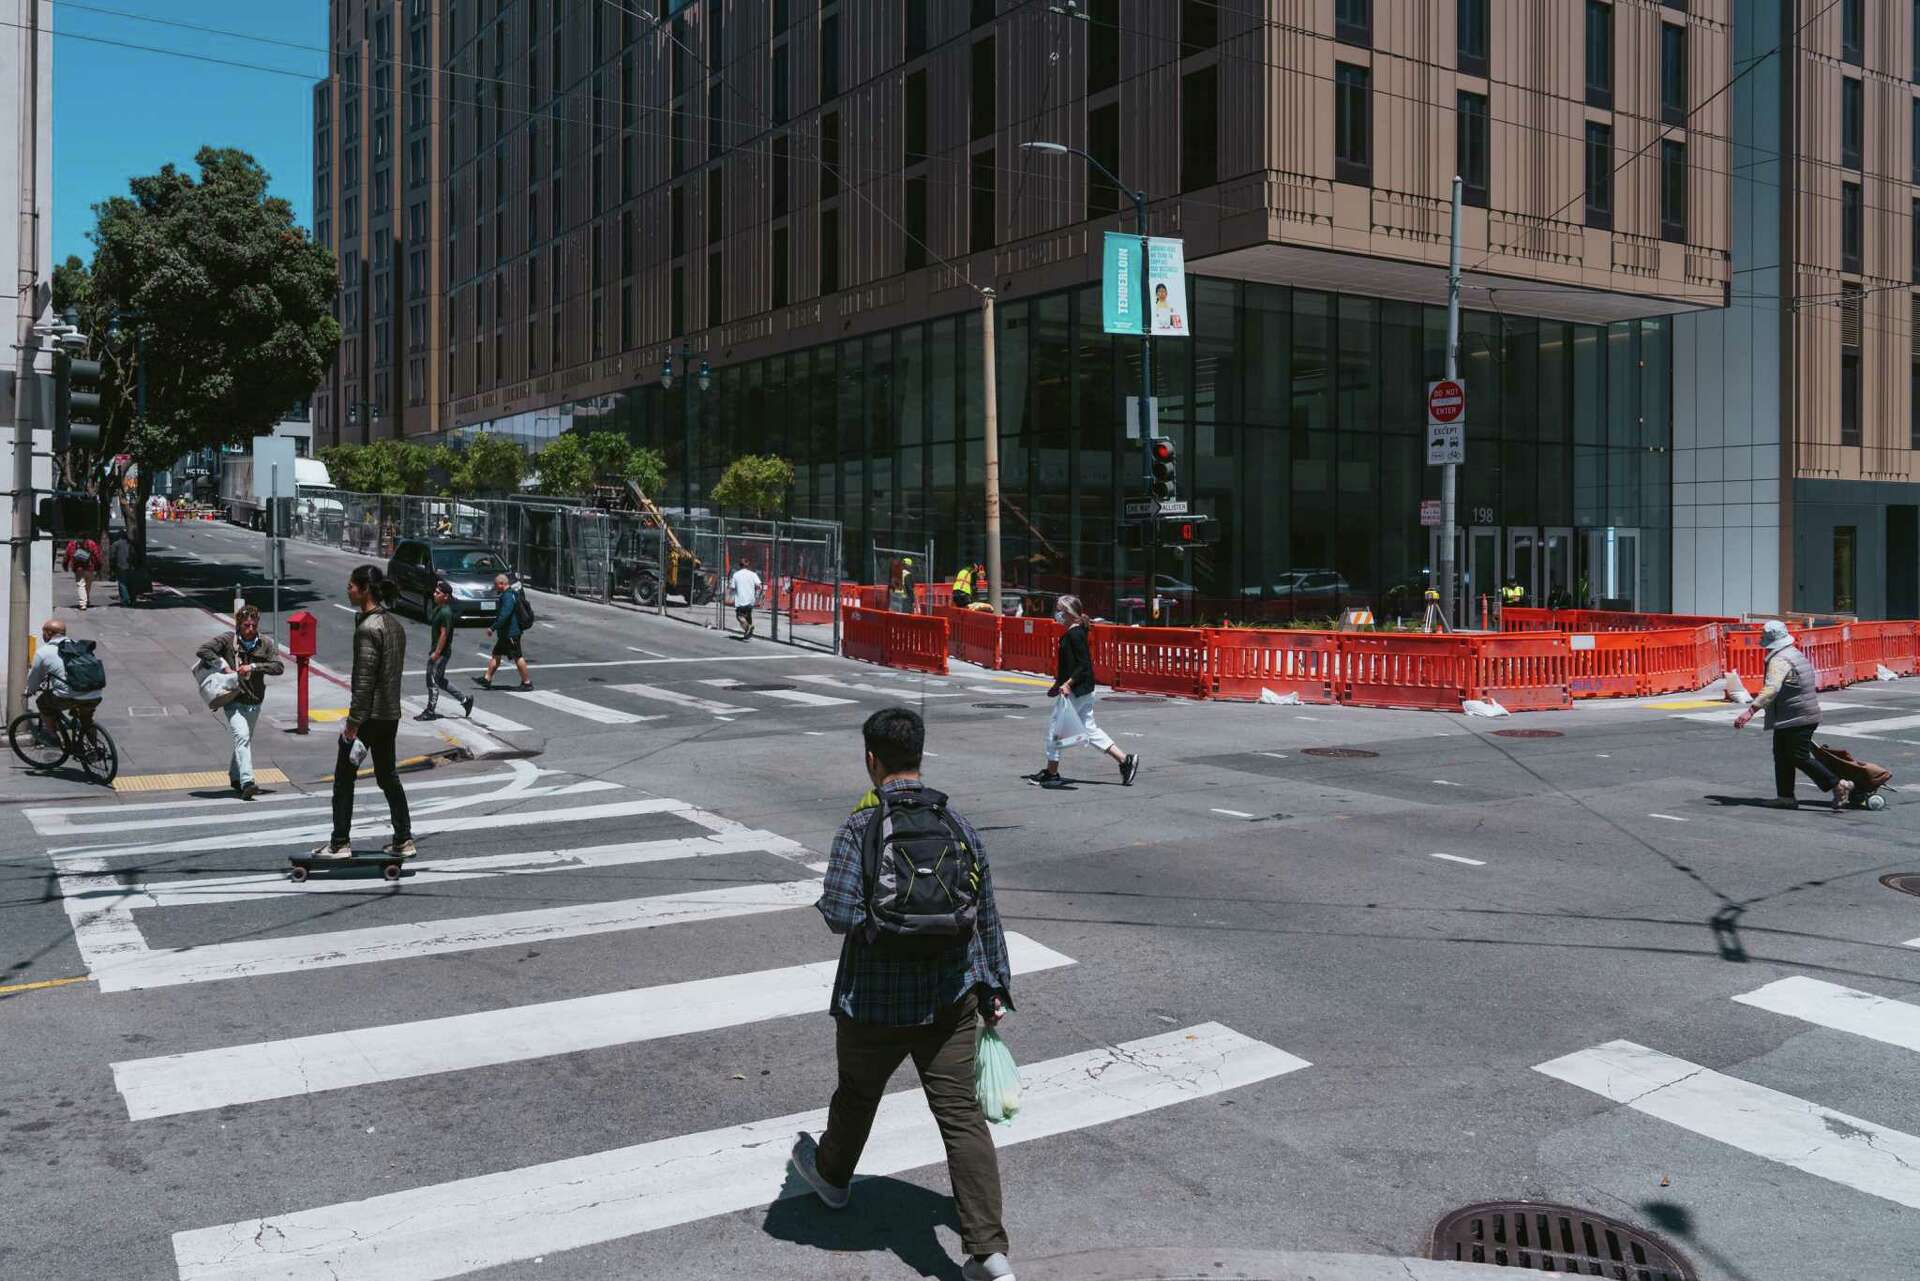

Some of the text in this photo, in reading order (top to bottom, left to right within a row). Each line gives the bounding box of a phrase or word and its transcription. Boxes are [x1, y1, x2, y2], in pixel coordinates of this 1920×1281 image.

[1118, 248, 1128, 314] TENDERLOIN
[1436, 407, 1456, 415] ENTER
[1434, 427, 1457, 435] EXCEPT
[1162, 503, 1185, 511] ALLISTER
[1473, 507, 1493, 523] 198
